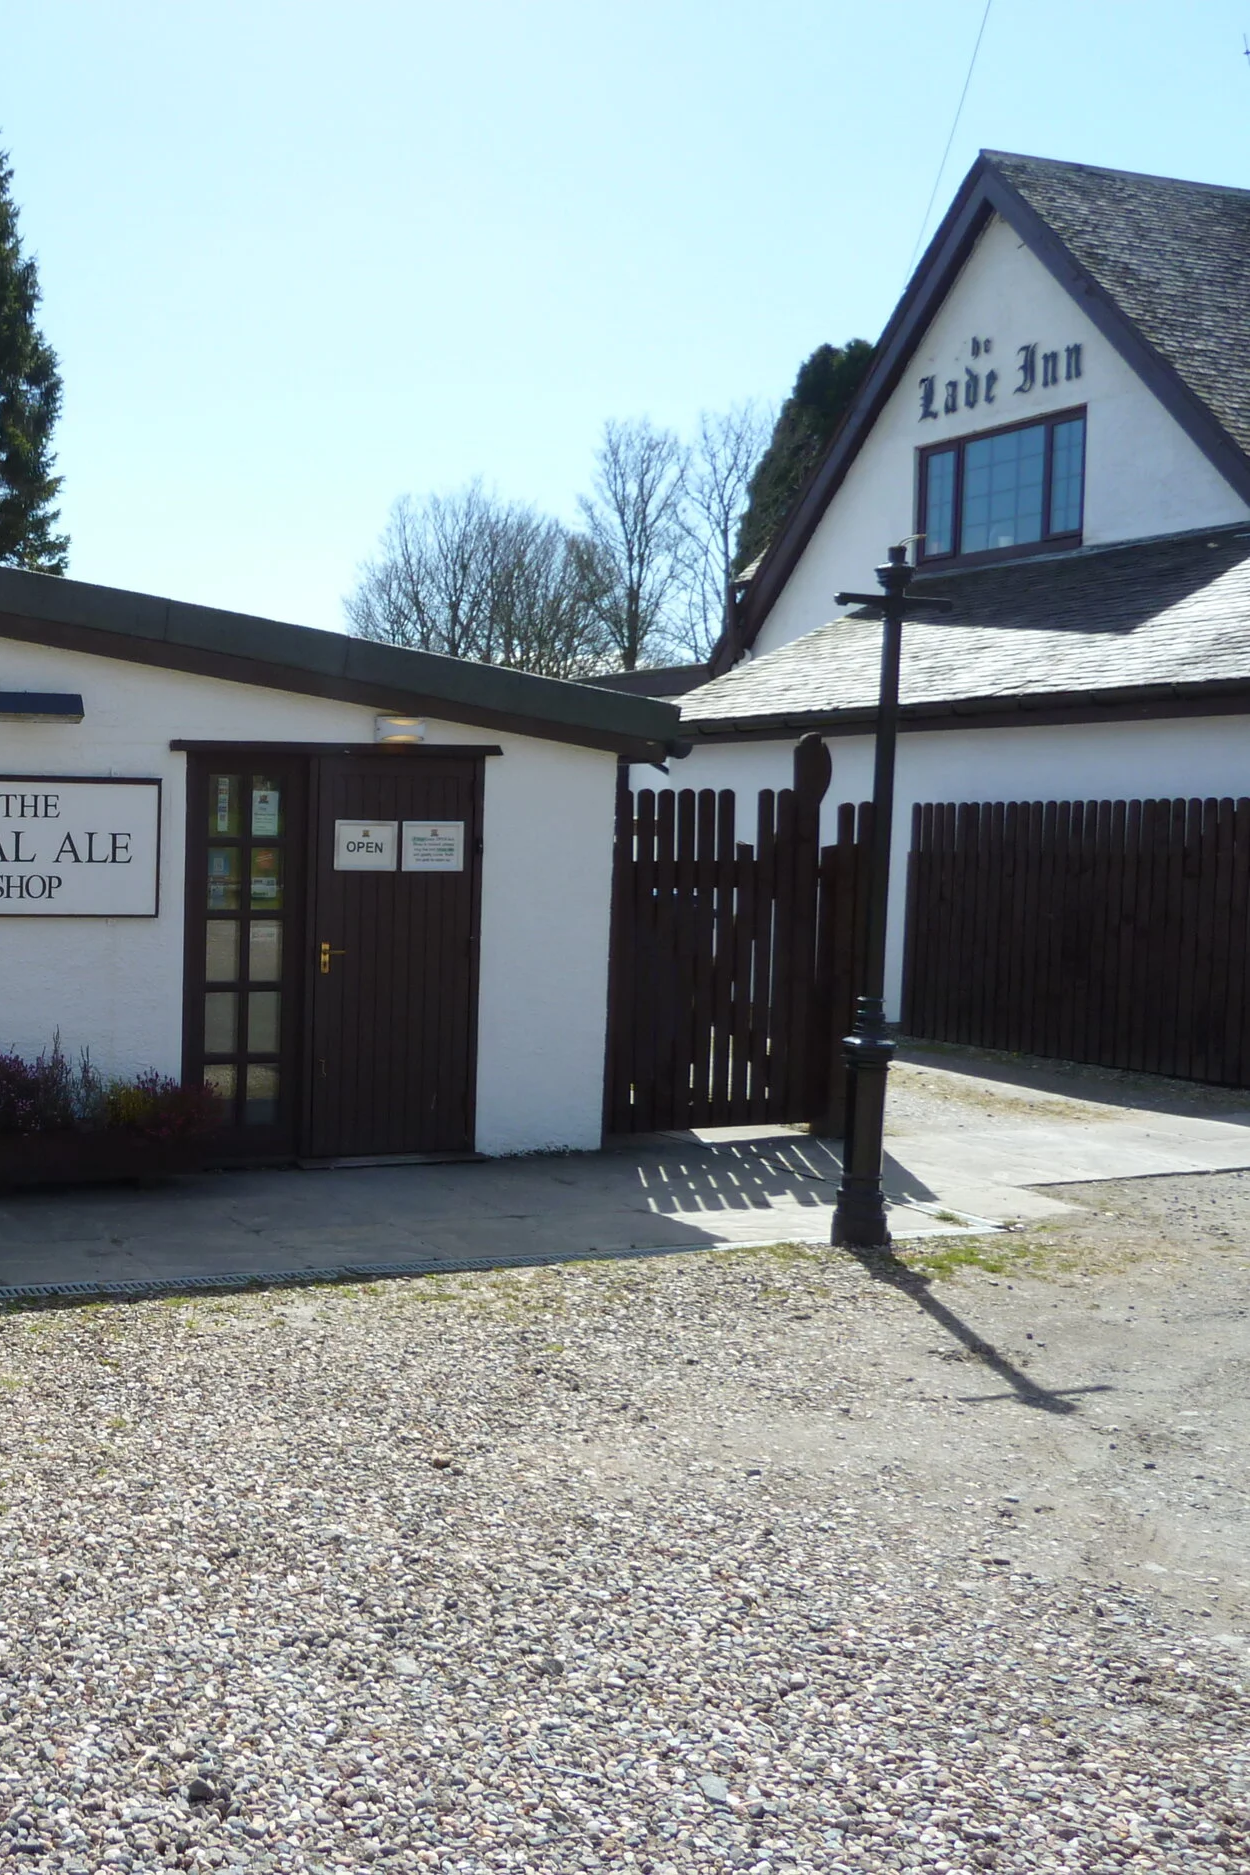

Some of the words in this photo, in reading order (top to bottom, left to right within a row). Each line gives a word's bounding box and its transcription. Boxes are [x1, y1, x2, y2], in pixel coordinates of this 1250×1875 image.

[918, 367, 998, 423] Lade
[1013, 342, 1085, 395] Inn
[52, 831, 133, 864] ALE
[346, 840, 384, 854] OPEN
